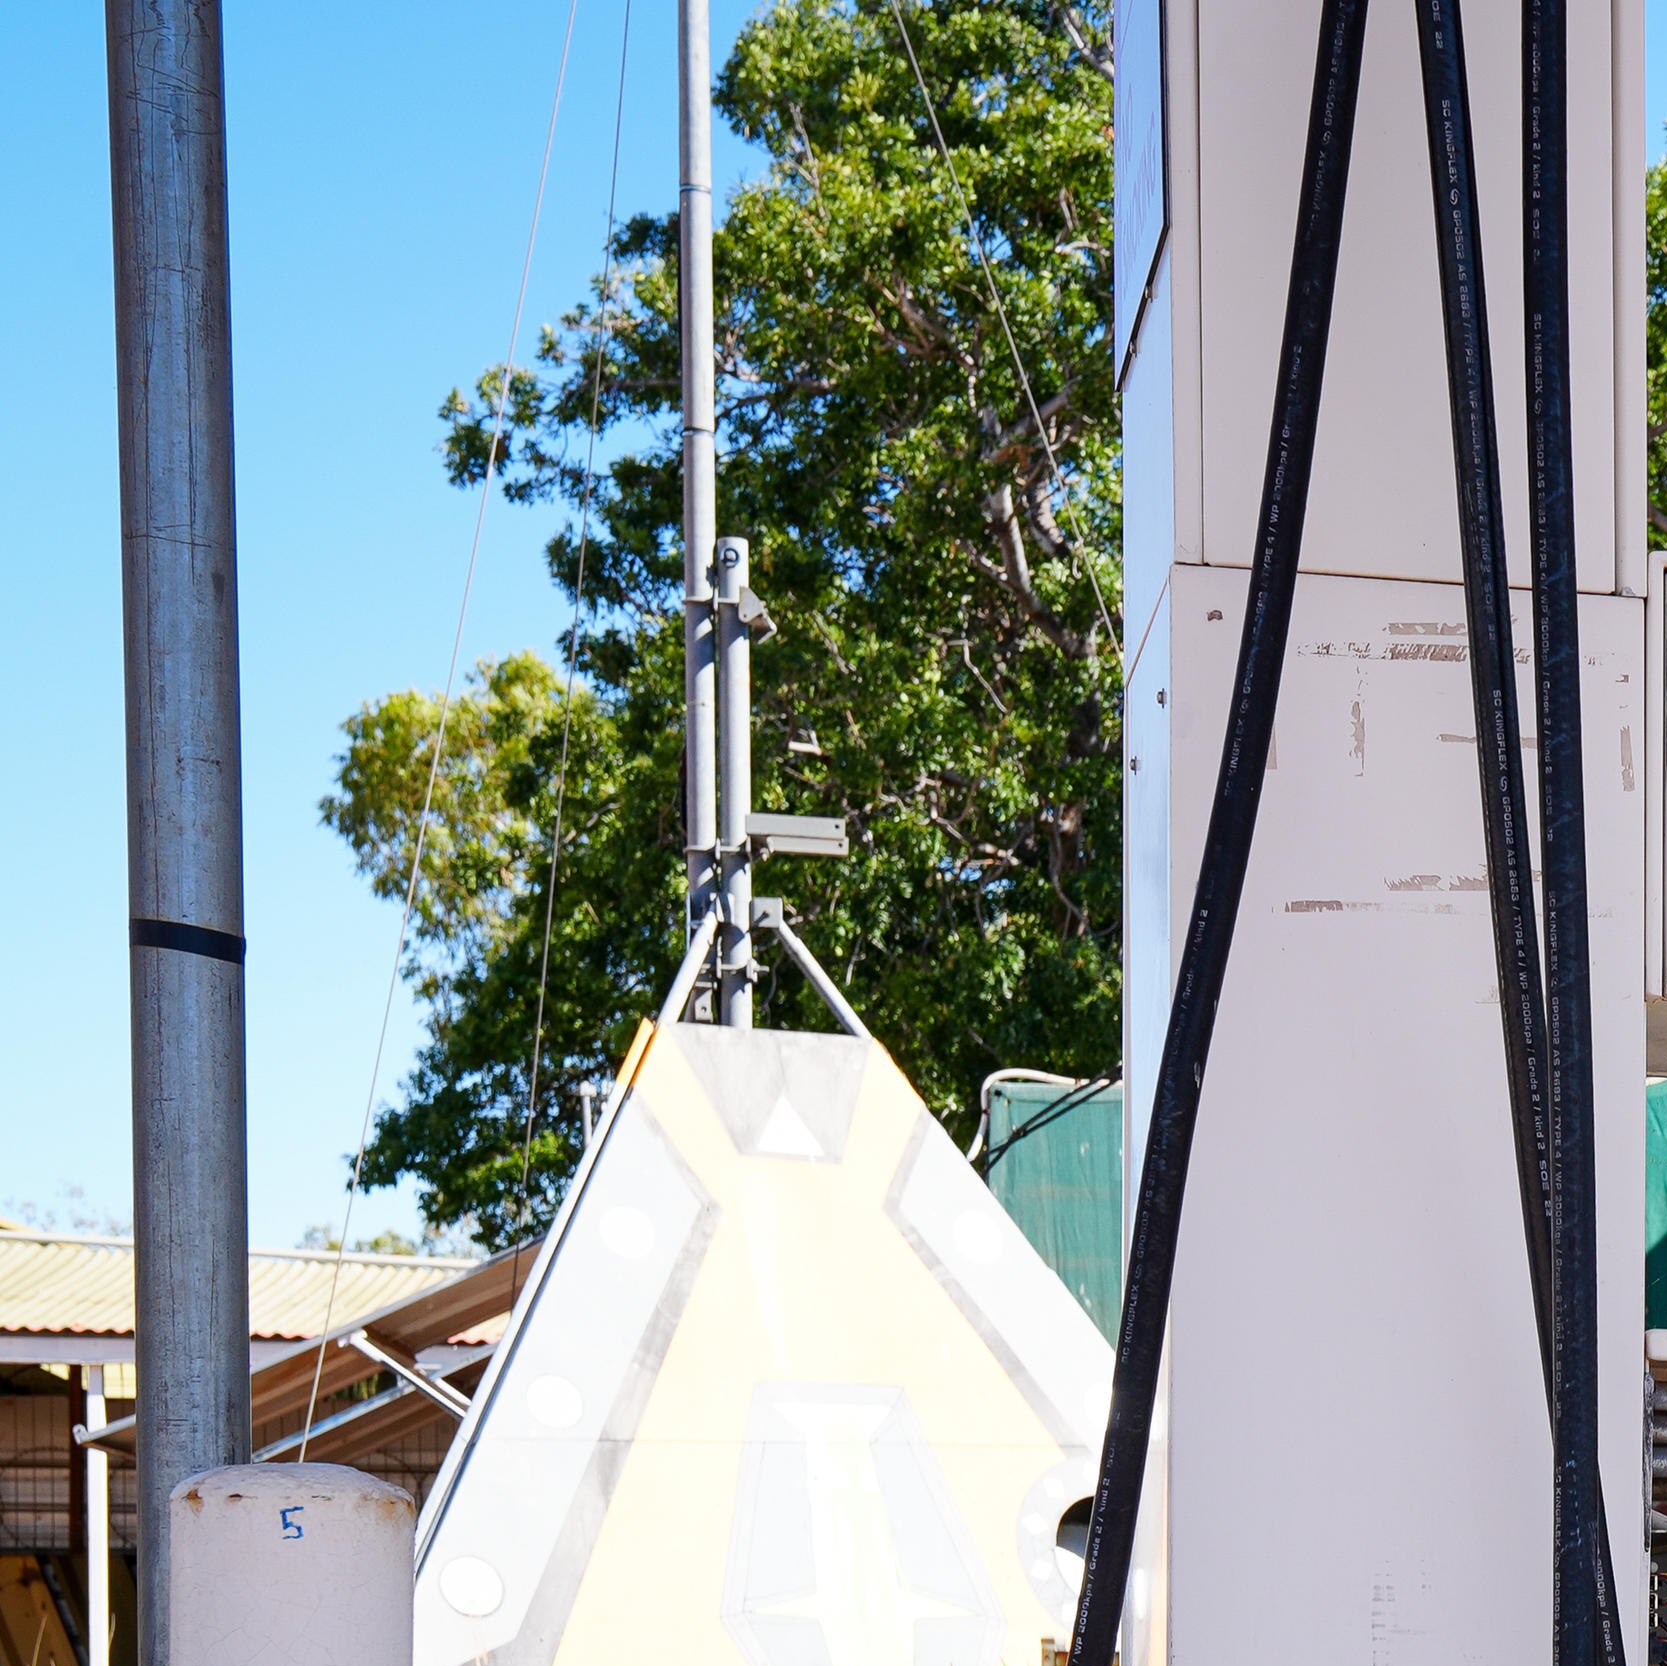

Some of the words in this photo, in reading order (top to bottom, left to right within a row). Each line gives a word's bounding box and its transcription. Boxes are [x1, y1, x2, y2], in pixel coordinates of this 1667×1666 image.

[1443, 121, 1458, 183] KINGFLEX
[1534, 333, 1544, 394] KINGFLEX
[1493, 690, 1501, 707] SC
[1494, 711, 1509, 771] KINGFLEX
[1502, 797, 1513, 844] GP0502
[1506, 849, 1516, 865] AS
[1508, 869, 1519, 902] 2683
[1513, 915, 1524, 946] TYPE
[1549, 911, 1559, 971] KINGFLEX
[1519, 972, 1528, 991] WP
[1521, 993, 1533, 1045] 2000kpa
[1551, 996, 1560, 1045] GP0502
[1527, 1057, 1538, 1091] Grade
[1534, 1115, 1544, 1139] kind
[1553, 1115, 1562, 1146] TYPE
[1539, 1160, 1550, 1191] SOE
[280, 1506, 304, 1540] 5
[1088, 1536, 1102, 1570] Grade
[1078, 1583, 1094, 1631] 2000kpa
[1074, 1635, 1085, 1656] WP
[1602, 1619, 1613, 1652] Grade
